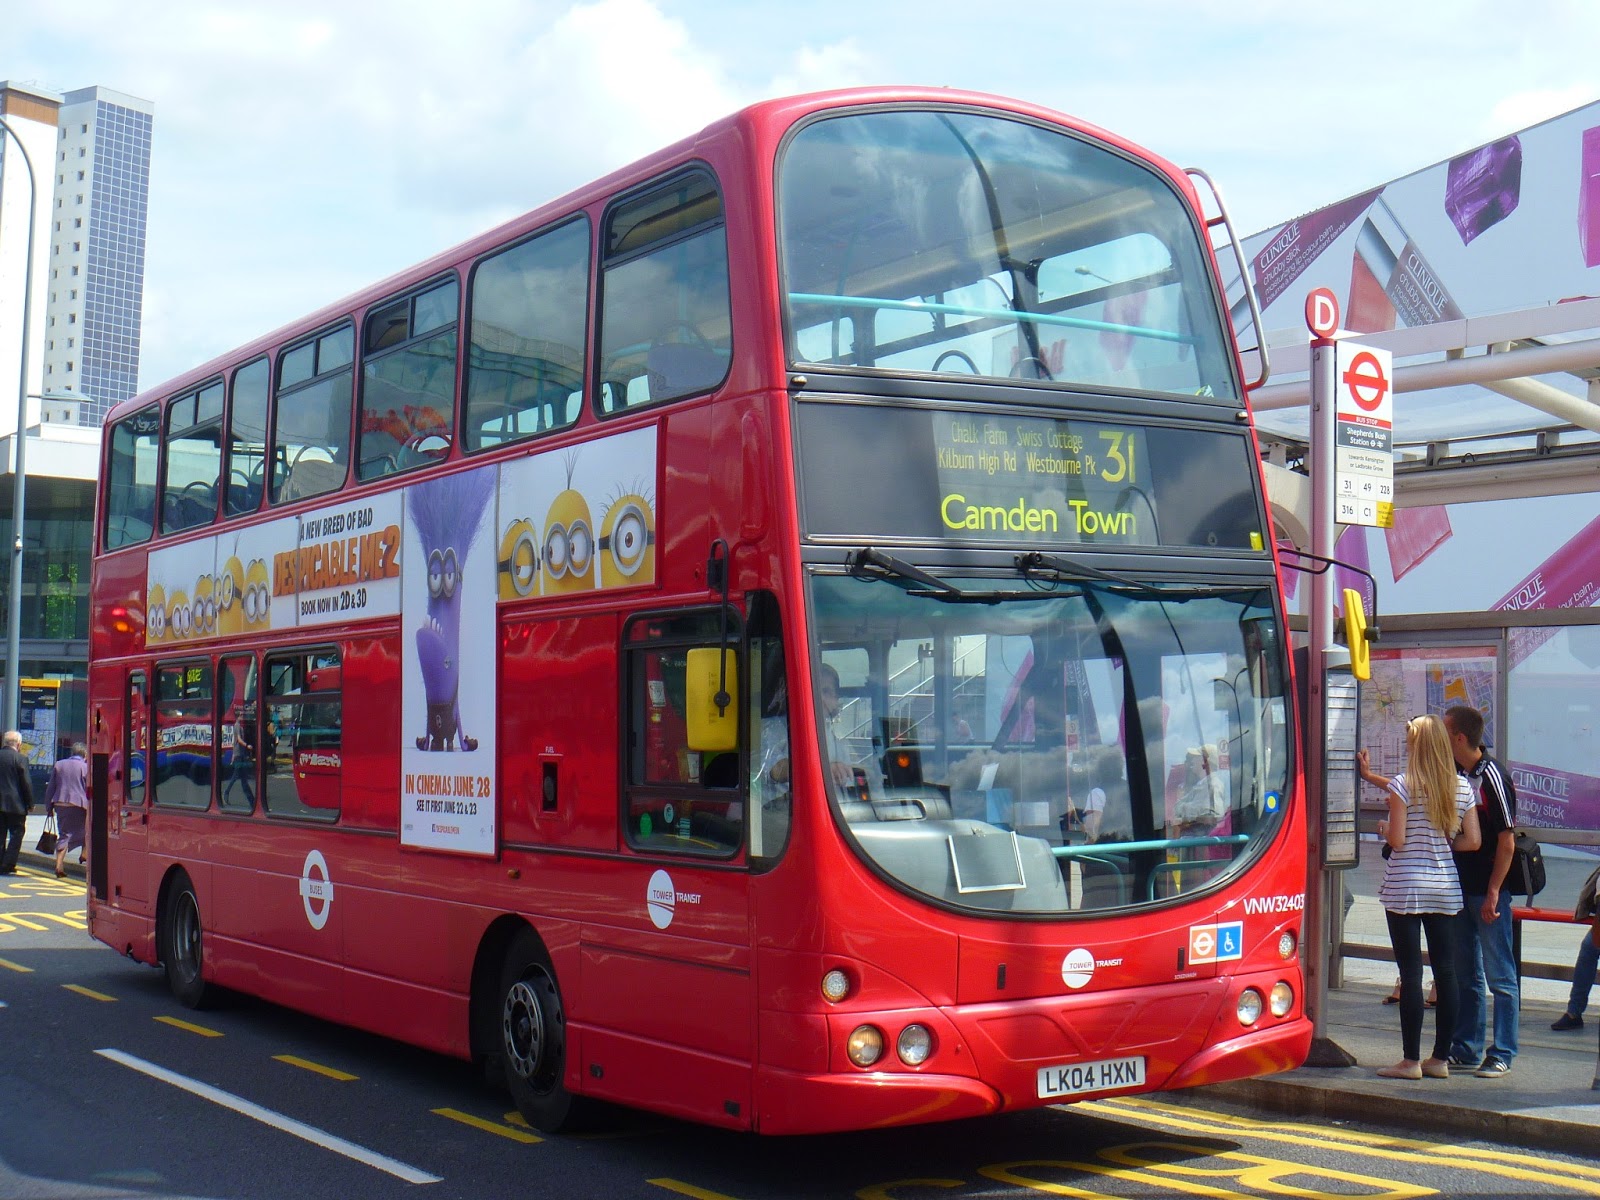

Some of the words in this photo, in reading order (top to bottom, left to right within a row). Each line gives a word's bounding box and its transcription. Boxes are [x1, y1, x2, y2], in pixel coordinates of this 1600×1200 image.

[1318, 225, 1334, 242] balm
[1260, 224, 1300, 269] CLINIQUE
[1263, 259, 1285, 286] chubby
[1285, 244, 1301, 264] stick
[1400, 273, 1421, 308] chubby
[1408, 253, 1448, 313] CLINIQUE
[1314, 294, 1335, 331] D
[1356, 416, 1366, 424] BUS
[1366, 418, 1378, 426] STOP
[951, 422, 979, 444] Chalk
[983, 424, 1008, 445] Farm
[1016, 426, 1043, 447] Swiss
[1046, 428, 1084, 453] Cottage
[1346, 427, 1374, 438] Shepherds
[1374, 431, 1387, 441] Bush
[1350, 436, 1369, 446] Station
[938, 448, 975, 469] Kilburn
[978, 450, 1000, 475] High
[1003, 451, 1017, 472] Rd
[1026, 453, 1082, 475] Westbourne
[1085, 455, 1097, 475] Pk
[1099, 430, 1136, 483] 31
[1364, 456, 1385, 465] Kensington
[1344, 480, 1352, 490] 31
[1363, 482, 1372, 492] 49
[1380, 484, 1390, 495] 228
[940, 493, 1058, 533] Camden
[1068, 499, 1137, 535] Town
[1342, 504, 1353, 515] 316
[1363, 507, 1371, 517] C1
[300, 523, 305, 541] A
[306, 519, 322, 540] NEW
[322, 513, 345, 536] BREED
[346, 511, 357, 530] OF
[357, 507, 373, 529] BAD
[273, 537, 358, 597] DESPICABLE
[301, 599, 316, 616] BOOK
[317, 596, 332, 613] NOW
[332, 595, 339, 611] IN
[340, 590, 351, 611] 2D
[351, 593, 356, 609] &
[356, 588, 367, 609] 3D
[1572, 582, 1594, 602] balm
[405, 774, 415, 795] IN
[416, 774, 452, 796] CINEMAS
[452, 775, 474, 797] JUNE
[476, 776, 491, 798] 28
[1511, 770, 1570, 796] CLINIQUE
[416, 799, 425, 812] SEE
[425, 800, 430, 812] IT
[430, 800, 444, 814] FIRST
[444, 801, 455, 814] JUNE
[456, 802, 464, 815] 22
[464, 804, 469, 815] &
[469, 802, 477, 816] 23
[1543, 803, 1565, 820] stick
[309, 884, 323, 896] BUSES
[652, 889, 673, 901] TOWER
[675, 892, 701, 905] TRANSIT
[1243, 893, 1306, 915] VNW32403
[1069, 961, 1093, 969] TOWER
[1095, 958, 1123, 968] TRANSIT
[1045, 1065, 1096, 1093] LK04
[1101, 1060, 1138, 1087] HXN
